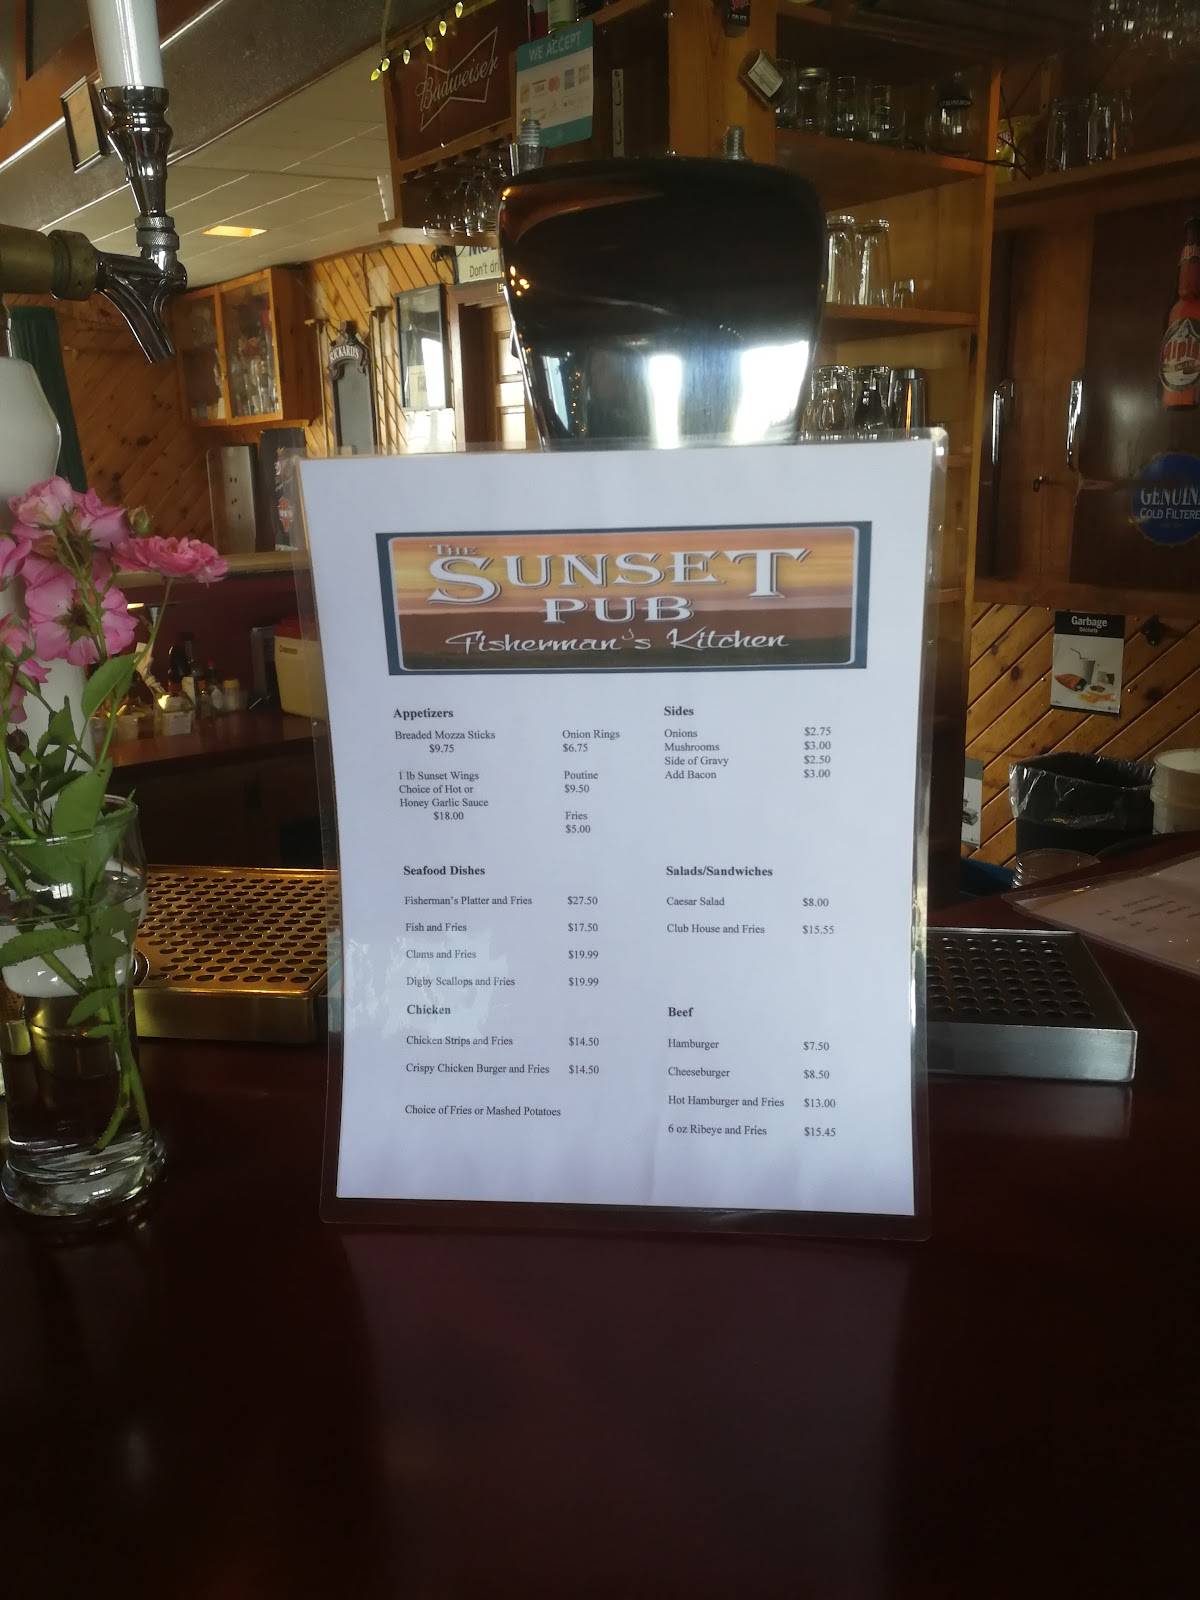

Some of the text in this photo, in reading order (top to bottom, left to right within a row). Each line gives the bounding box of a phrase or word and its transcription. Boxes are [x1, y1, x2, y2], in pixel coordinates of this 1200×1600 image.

[415, 57, 498, 112] Budweiser
[1140, 486, 1200, 506] GENUIN
[427, 548, 812, 605] SUNSET
[543, 596, 695, 624] PUB
[1071, 615, 1108, 629] Garbage
[445, 626, 790, 654] Fisherman's Kitchen
[393, 708, 453, 720] Appetizers
[664, 706, 694, 716] Sides
[395, 730, 495, 740] Breaded Mozza Sticks
[562, 729, 620, 740] Onion Rings
[664, 729, 698, 738] Onions
[804, 727, 831, 736] $2.75
[429, 744, 454, 753] $9.75
[563, 743, 588, 752] $6.75
[665, 742, 720, 751] Mushrooms
[804, 741, 831, 750] $3.00
[665, 756, 729, 767] Side of Gravy
[804, 755, 831, 764] $2.50
[399, 771, 479, 781] 1 lb Sunset Wings
[564, 770, 598, 780] Poutine
[665, 770, 717, 779] Add Bacon
[803, 769, 830, 778] $3.00
[399, 784, 430, 793] Choice
[433, 785, 443, 793] of
[445, 785, 462, 793] Hot
[565, 784, 589, 793] $9.50
[400, 798, 488, 809] Honey Garlic Sauce
[433, 811, 464, 820] $18.00
[565, 811, 588, 820] Fries
[566, 824, 590, 834] $5.00
[404, 866, 485, 875] Seafood Dishes
[666, 866, 773, 876] Salads/Sandwiches
[404, 896, 532, 904] Fisherman's Platter and Fries
[568, 896, 598, 905] $27.50
[667, 897, 725, 906] Caesar Salad
[803, 898, 829, 907] $8.00
[406, 923, 467, 932] Fish and Fries
[568, 923, 598, 932] $17.50
[667, 924, 765, 934] Club House and Fries
[803, 925, 834, 934] $15.55
[406, 949, 477, 959] Clams and Fries
[569, 950, 598, 959] $19.99
[406, 976, 515, 988] Digby Scallops and Fries
[569, 977, 599, 986] $19.99
[407, 1004, 451, 1015] Chicken
[668, 1007, 694, 1017] Beef
[406, 1035, 513, 1047] Chicken Strips and Fries
[569, 1036, 599, 1047] $14.50
[668, 1038, 719, 1051] Hamburger
[803, 1041, 829, 1051] $7.50
[406, 1063, 549, 1075] Crispy Chicken Burger and Fries
[569, 1065, 599, 1074] $14.50
[668, 1067, 730, 1079] Cheeseburger
[804, 1070, 830, 1079] $8.50
[669, 1096, 784, 1108] Hot Hamburger and Fries
[804, 1098, 836, 1108] $13.00
[405, 1105, 436, 1114] Choice
[438, 1105, 449, 1114] of
[450, 1105, 473, 1115] Fries
[486, 1106, 522, 1115] Mashed
[524, 1106, 562, 1116] Potatoes
[668, 1124, 767, 1136] 6 oz Ribeye and Fries
[804, 1127, 836, 1137] $15.45
